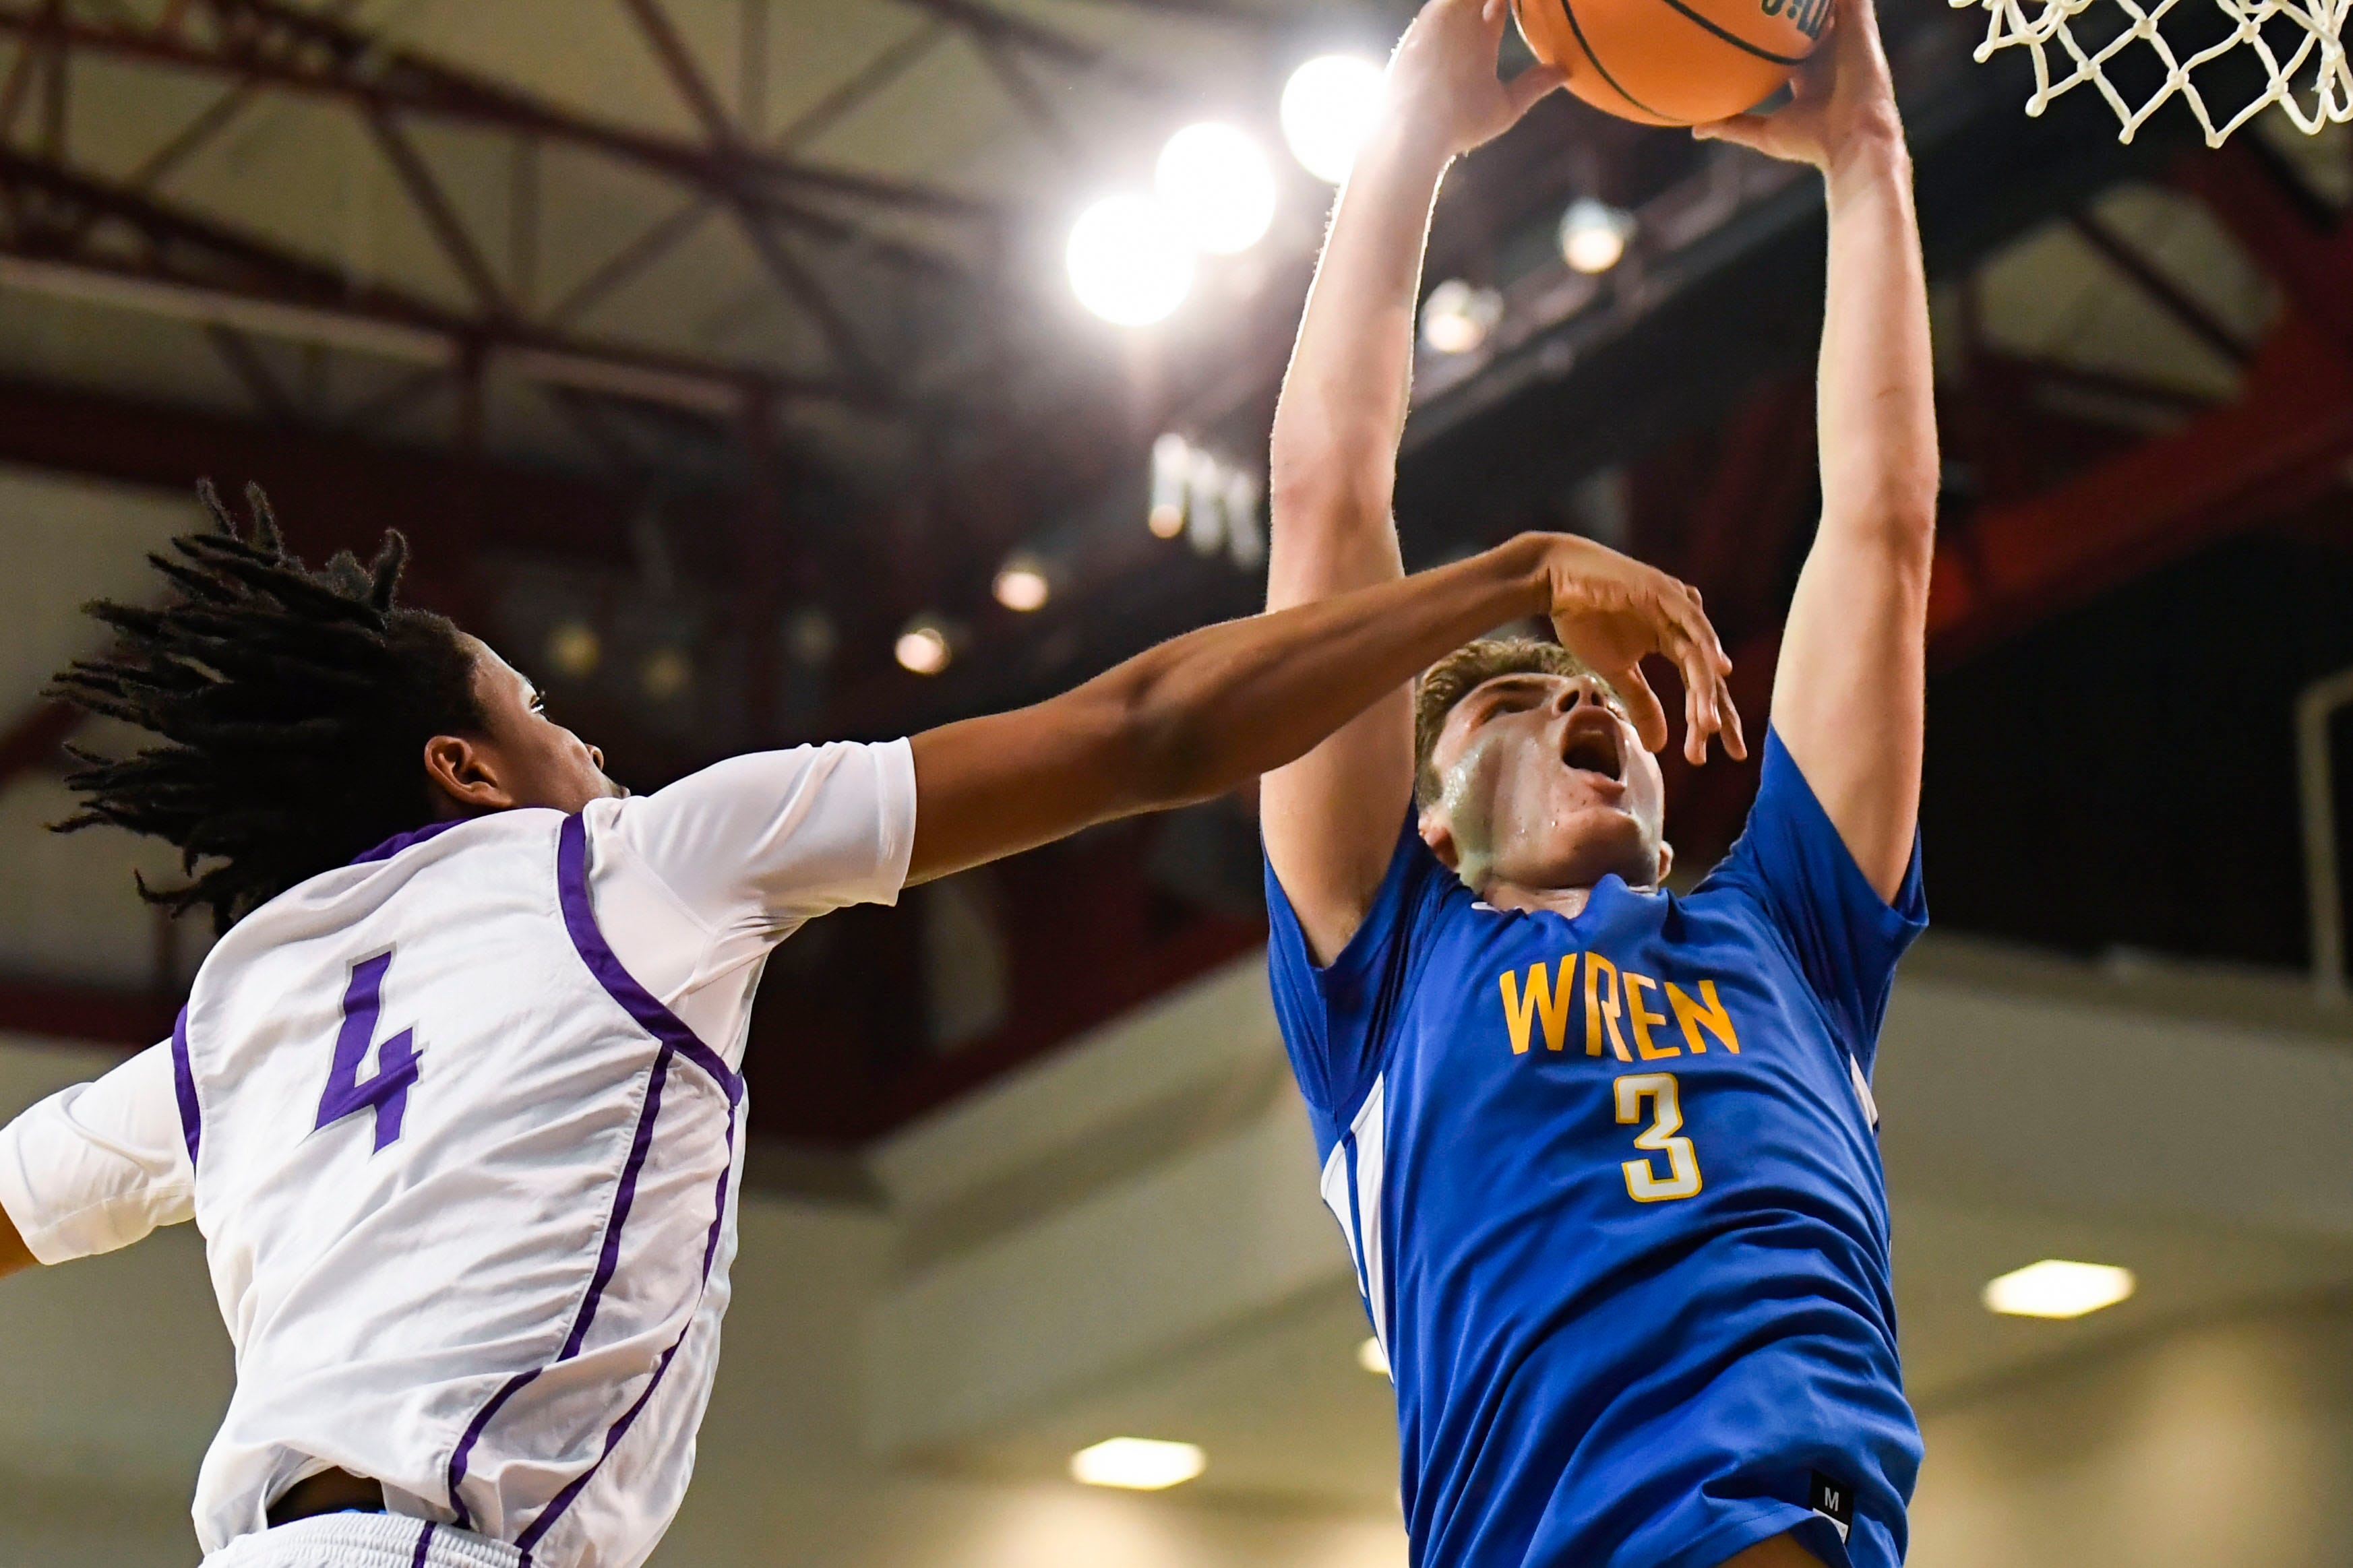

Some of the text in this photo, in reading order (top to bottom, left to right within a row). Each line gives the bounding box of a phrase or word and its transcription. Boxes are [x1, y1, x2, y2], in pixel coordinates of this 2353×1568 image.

[309, 943, 427, 1159] 4
[1499, 951, 1740, 1062] WREN
[1613, 1072, 1703, 1203] 3
[1824, 1486, 1839, 1512] M
